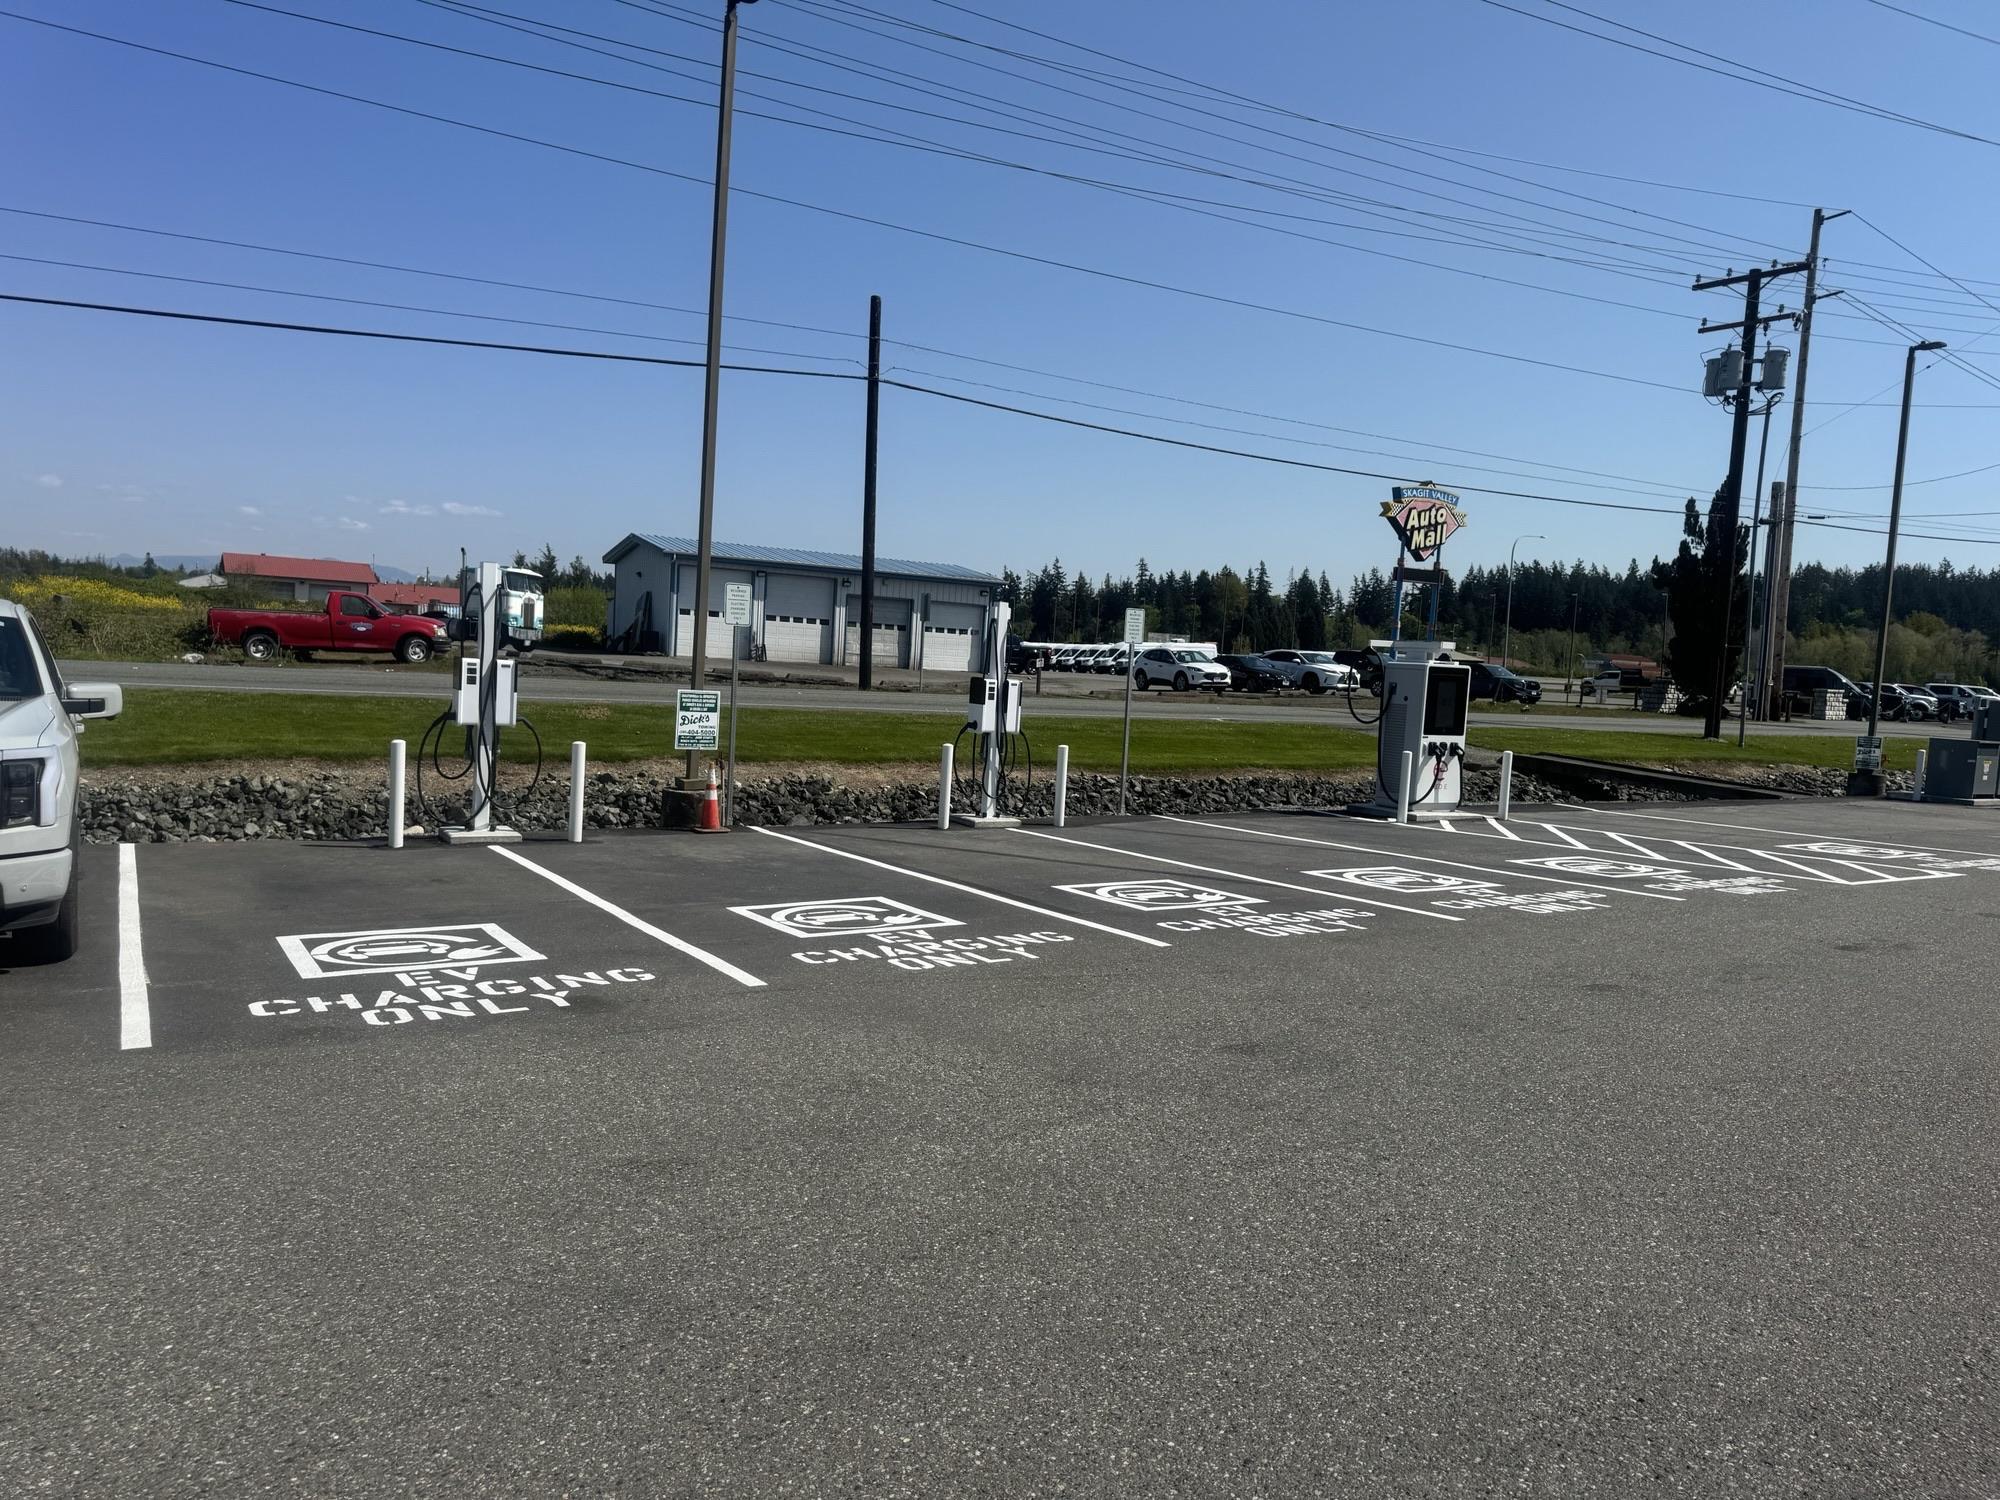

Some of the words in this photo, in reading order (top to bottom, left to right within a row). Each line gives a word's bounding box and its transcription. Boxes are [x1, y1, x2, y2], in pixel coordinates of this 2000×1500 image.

[1402, 488, 1430, 498] SKAGIT
[1431, 490, 1457, 503] VALLEY
[1406, 506, 1447, 529] Auto
[1410, 524, 1447, 550] Mall
[680, 713, 710, 726] Dick's
[1156, 908, 1377, 931] CHARGING
[1196, 905, 1259, 917] EV
[866, 929, 935, 944] EV
[1244, 919, 1368, 937] ONLY
[791, 931, 1075, 964] CHARGING
[887, 946, 1041, 970] ONLY
[395, 966, 479, 988] EV
[247, 967, 657, 1017] CHARGING
[360, 990, 572, 1026] ONLY
